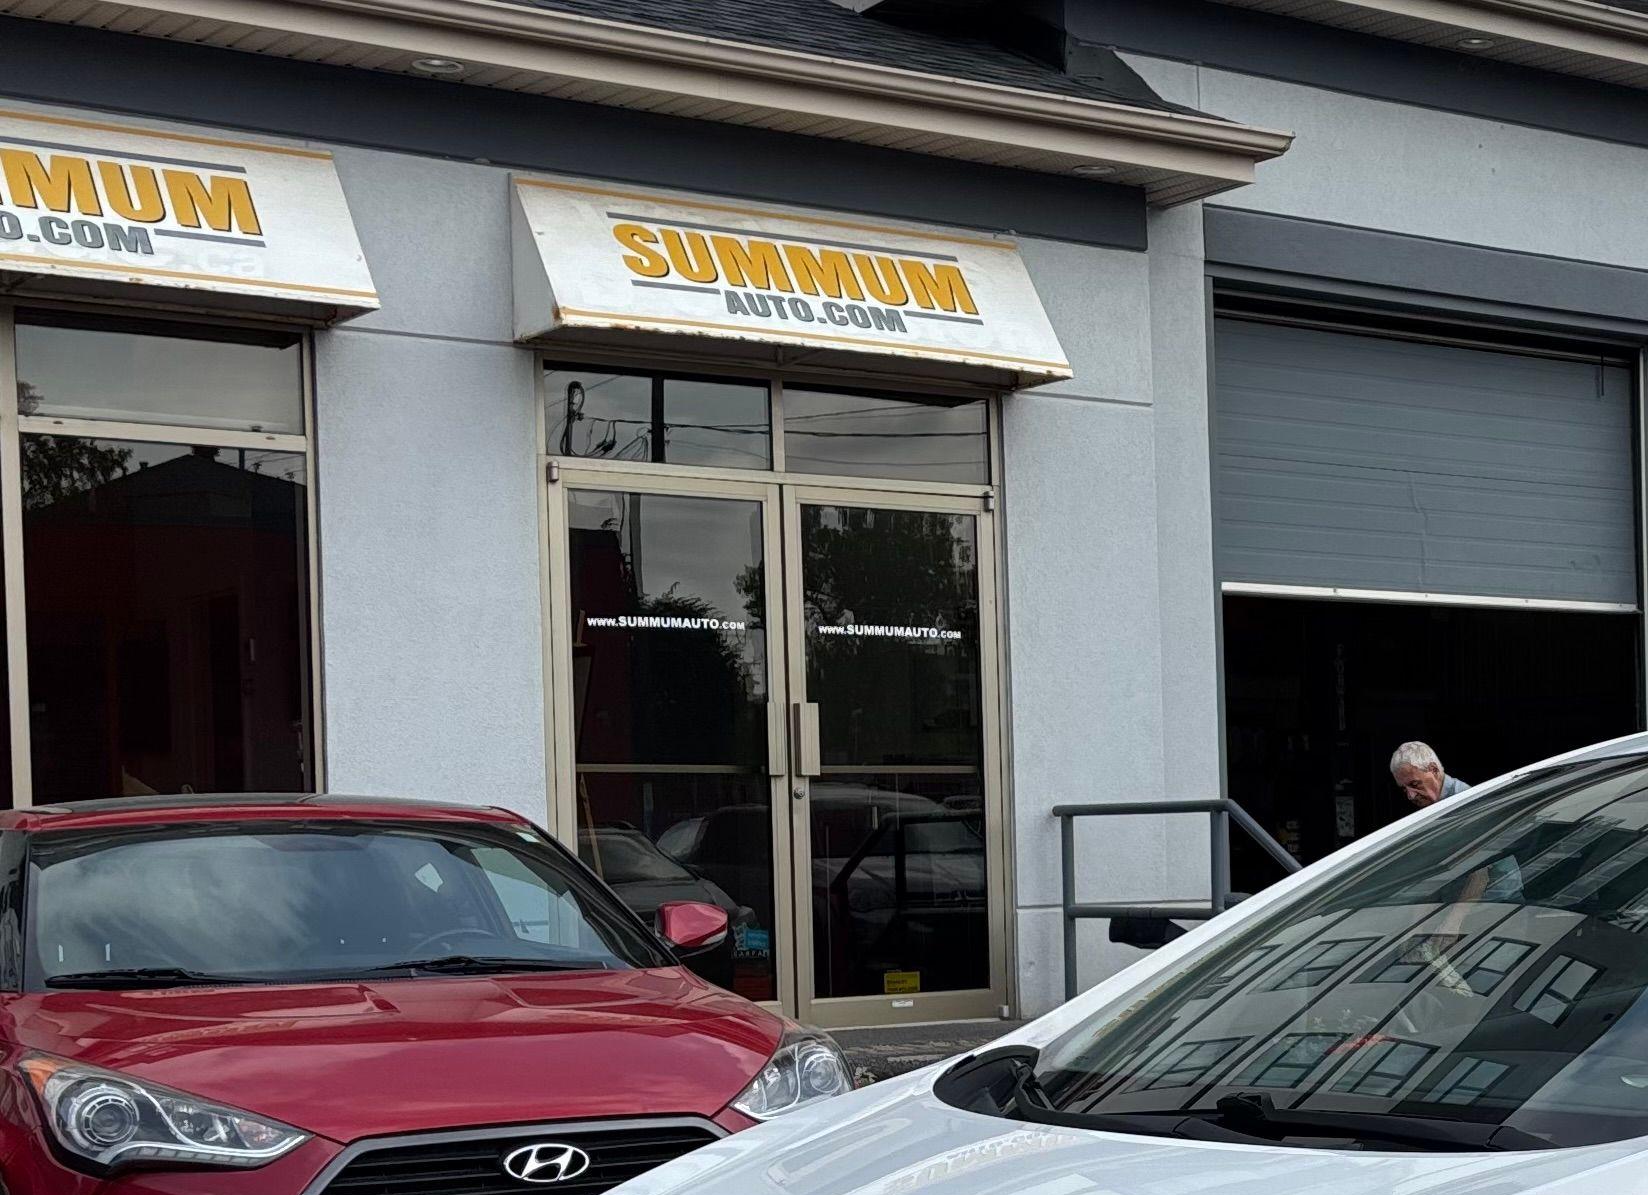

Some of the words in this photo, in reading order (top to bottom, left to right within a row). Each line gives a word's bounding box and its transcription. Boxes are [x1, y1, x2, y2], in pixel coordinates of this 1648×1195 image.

[0, 147, 263, 237] MUM
[612, 223, 980, 316] SUMMUM
[726, 290, 908, 333] AUTO.COM
